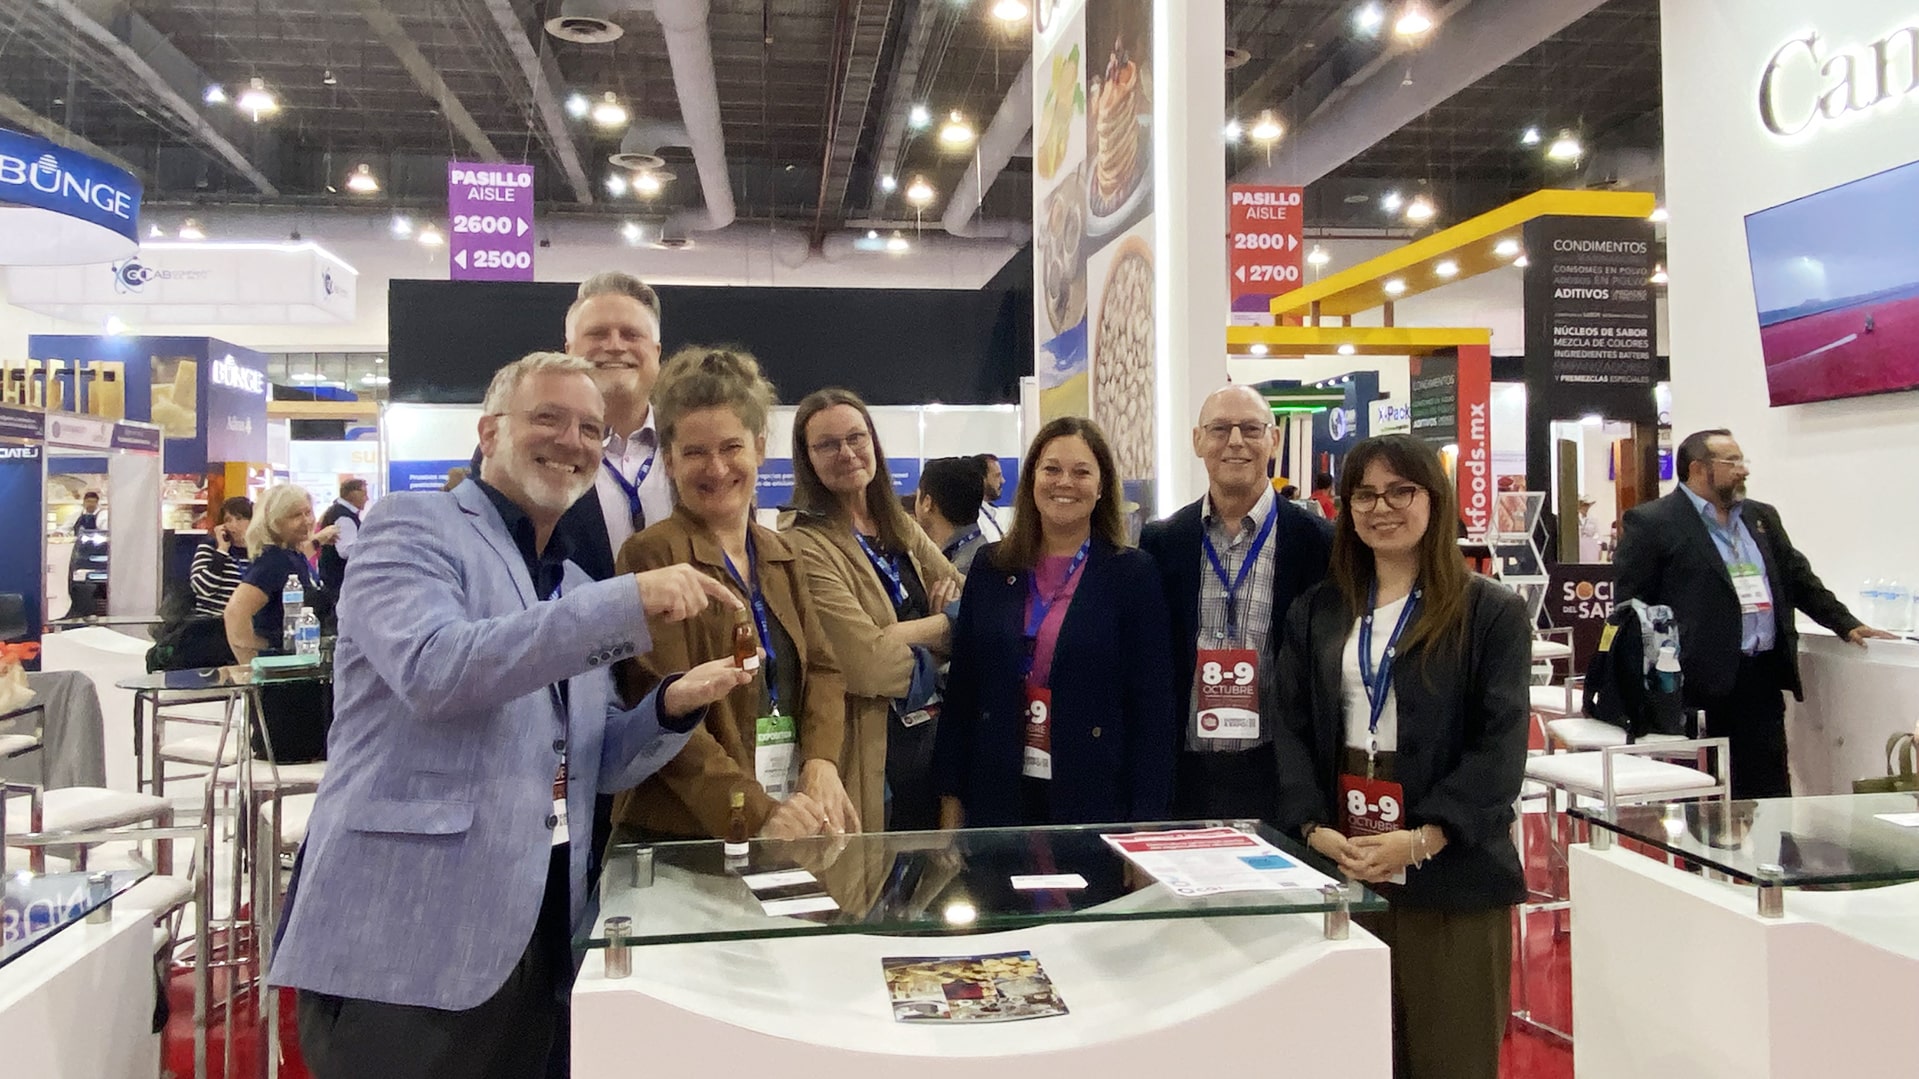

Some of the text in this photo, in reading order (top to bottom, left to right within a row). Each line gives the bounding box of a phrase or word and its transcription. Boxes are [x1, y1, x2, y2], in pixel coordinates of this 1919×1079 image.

[0, 154, 131, 219] BUNGE
[452, 170, 531, 188] PASILLO
[468, 187, 515, 202] AISLE
[1232, 192, 1301, 206] PASILLO
[1246, 206, 1287, 220] AISLE
[453, 215, 512, 234] 2600
[1234, 233, 1284, 250] 2800
[1553, 239, 1648, 254] CONDIMENTOS
[473, 250, 531, 269] 2500
[1249, 265, 1299, 282] 2700
[1554, 287, 1610, 300] ADITIVOS
[1553, 325, 1648, 337] NÚCLEOS DE SABOR
[1553, 338, 1649, 348] MEZCLA DE COLORES
[1553, 349, 1618, 359] INGREDIENTES
[1562, 605, 1578, 614] DEL
[1202, 661, 1255, 686] 8-9
[1202, 685, 1255, 695] OCTUBRE
[1347, 789, 1400, 823] 8-9
[1348, 815, 1400, 832] OCTUBRE
